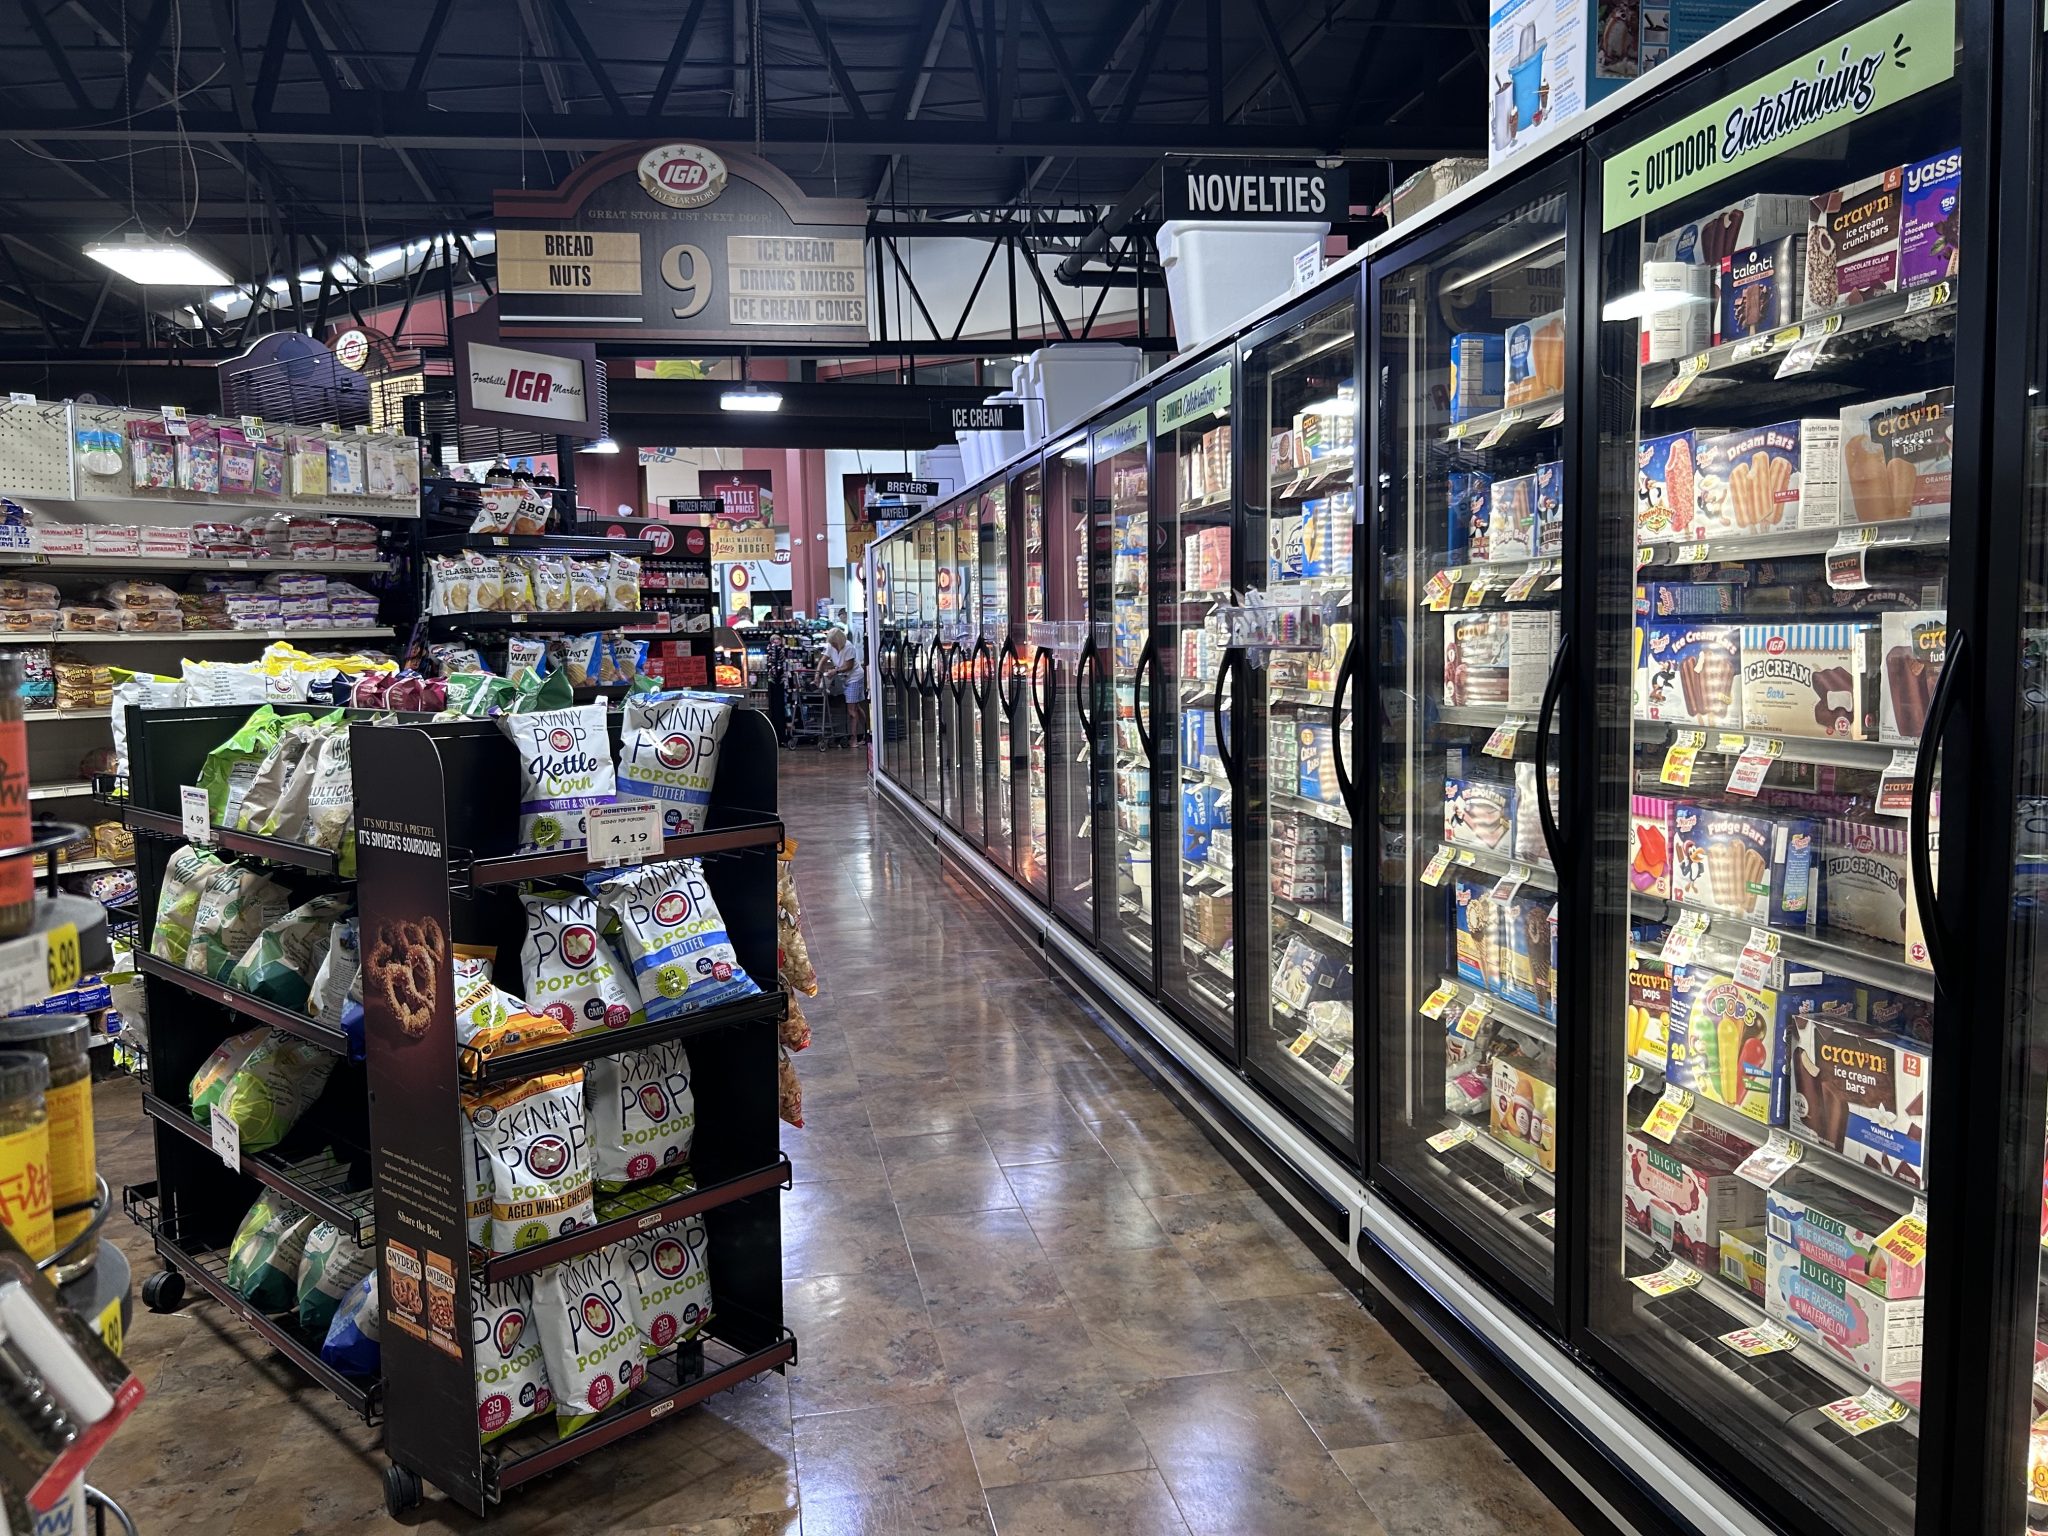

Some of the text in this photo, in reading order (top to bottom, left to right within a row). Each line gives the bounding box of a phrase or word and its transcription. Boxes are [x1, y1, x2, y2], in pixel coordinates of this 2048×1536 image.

[1646, 46, 1885, 195] OUTDOOR Entertaining
[663, 165, 703, 183] IGA
[1889, 171, 1896, 182] 6
[692, 189, 715, 203] STORE
[1188, 174, 1326, 213] NOVELTIES
[1941, 196, 1956, 208] 150
[588, 209, 628, 220] GREAT
[631, 211, 668, 220] STORE
[672, 211, 700, 221] JUST
[704, 212, 735, 221] NEXT
[1834, 194, 1890, 232] crav'n
[1904, 218, 1918, 228] mint
[1842, 224, 1889, 251] crunch bars
[1846, 216, 1884, 239] ice cream
[1904, 221, 1934, 236] chocolate
[545, 234, 594, 257] BREAD
[1904, 232, 1924, 244] crunch
[757, 240, 835, 263] ICE CREAM
[1733, 256, 1773, 281] talenti
[1843, 255, 1890, 274] CHOCOLATE ECLAIR
[549, 264, 591, 286] NUTS
[660, 244, 713, 318] 9
[739, 269, 855, 292] DRINKS MIXERS
[734, 298, 863, 322] ICE CREAM CONES
[472, 368, 581, 403] Foothills IGA Market
[952, 409, 1002, 429] ICE CREAM
[1877, 403, 1942, 437] crav'n
[1727, 431, 1795, 461] Dream Bars
[1891, 426, 1934, 448] ice cream
[1903, 442, 1924, 455] bars
[887, 482, 928, 494] BREYERS
[519, 500, 546, 516] BBQ
[677, 500, 717, 512] FROZEN FRUIT
[736, 505, 755, 514] PRICES
[881, 507, 909, 519] MAYFIELD
[14, 526, 27, 534] 12
[127, 529, 138, 537] 12
[179, 531, 188, 539] 12
[17, 538, 30, 546] 12
[73, 543, 83, 551] 12
[712, 543, 771, 558] Your BUDGET
[1852, 592, 1918, 611] Ice Cream Bars
[1671, 638, 1686, 653] Ice
[1686, 631, 1716, 643] Cream
[1768, 640, 1785, 651] IGA
[511, 653, 537, 662] WAVY
[1744, 658, 1811, 688] ICE CREAM
[1766, 686, 1785, 699] Bars
[531, 710, 582, 727] SKINNY
[641, 703, 722, 735] SKINNY
[1838, 721, 1848, 732] 12
[533, 727, 587, 753] POP
[631, 732, 719, 774] POP
[528, 752, 598, 785] Kettle
[628, 765, 709, 790] POPCORN
[546, 776, 594, 797] Corn
[652, 785, 686, 801] BUTTER
[550, 798, 597, 810] SWEET & SALTY
[603, 807, 636, 815] HOMETOWN
[1194, 790, 1207, 825] OREO
[190, 815, 204, 825] 4.99
[363, 817, 436, 838] IT'S NOT JUST A PRETZEL
[540, 821, 553, 832] 56
[666, 815, 680, 823] GMO
[359, 829, 441, 858] IT'S SNYDER'S SOURDOUGH
[610, 832, 648, 845] 4.19
[1708, 820, 1766, 847] Fudge Bars
[1856, 839, 1873, 849] IGA
[624, 857, 698, 904] SKINNY
[1829, 856, 1898, 890] FUDGE BARS
[205, 877, 241, 894] JULY
[1674, 888, 1684, 901] 12
[629, 881, 706, 940] POP
[641, 918, 717, 952] POPCORN
[671, 936, 706, 958] BUTTER
[1911, 947, 1925, 958] 12
[48, 940, 76, 988] 6.99
[699, 964, 712, 974] GMO
[715, 968, 731, 980] FREE
[1630, 971, 1670, 991] crav'n
[1716, 984, 1738, 995] LOTTA
[1642, 988, 1661, 1000] pops
[480, 1005, 492, 1017] 47
[587, 1007, 604, 1018] GMO
[608, 1013, 628, 1026] FREE
[1715, 997, 1757, 1027] POPS
[1671, 1043, 1686, 1061] 20
[1820, 1044, 1883, 1073] crav'n
[1906, 1056, 1917, 1069] 12
[1834, 1065, 1877, 1087] ice cream
[1494, 1076, 1516, 1097] LINDY'S
[1845, 1080, 1866, 1095] bars
[621, 1072, 688, 1131] POP
[498, 1092, 583, 1145] SKINNY
[1702, 1122, 1729, 1144] CHERRY
[1870, 1125, 1894, 1141] VANILLA
[498, 1124, 587, 1184] POP
[636, 1157, 649, 1171] 39
[1649, 1149, 1682, 1179] LUIGI'S
[511, 1167, 590, 1200] POPCORN
[1652, 1177, 1676, 1198] CHERRY
[507, 1198, 566, 1219] AGED WHITE
[397, 1210, 442, 1240] Share the Best.
[526, 1227, 539, 1239] 47
[1806, 1209, 1844, 1237] LUIGI'S
[1797, 1225, 1849, 1258] BLUE RASPBERRY
[1885, 1239, 1916, 1263] Value
[628, 1227, 706, 1295] POP
[1804, 1243, 1848, 1271] WATERMELON
[559, 1246, 618, 1305] SKINNY
[1802, 1260, 1844, 1294] LUIGI'S
[1794, 1282, 1849, 1324] BLUE RASPBERRY
[568, 1279, 626, 1355] POP
[657, 1317, 670, 1331] 39
[685, 1310, 698, 1322] GMO
[1801, 1302, 1847, 1337] WATERMELON
[1728, 1331, 1763, 1349] 3.48
[621, 1366, 633, 1382] GMO
[595, 1378, 608, 1394] 39
[487, 1399, 502, 1415] 39
[522, 1390, 536, 1405] GMO
[485, 1411, 505, 1422] CALORIES
[1829, 1399, 1869, 1422] 2.48
